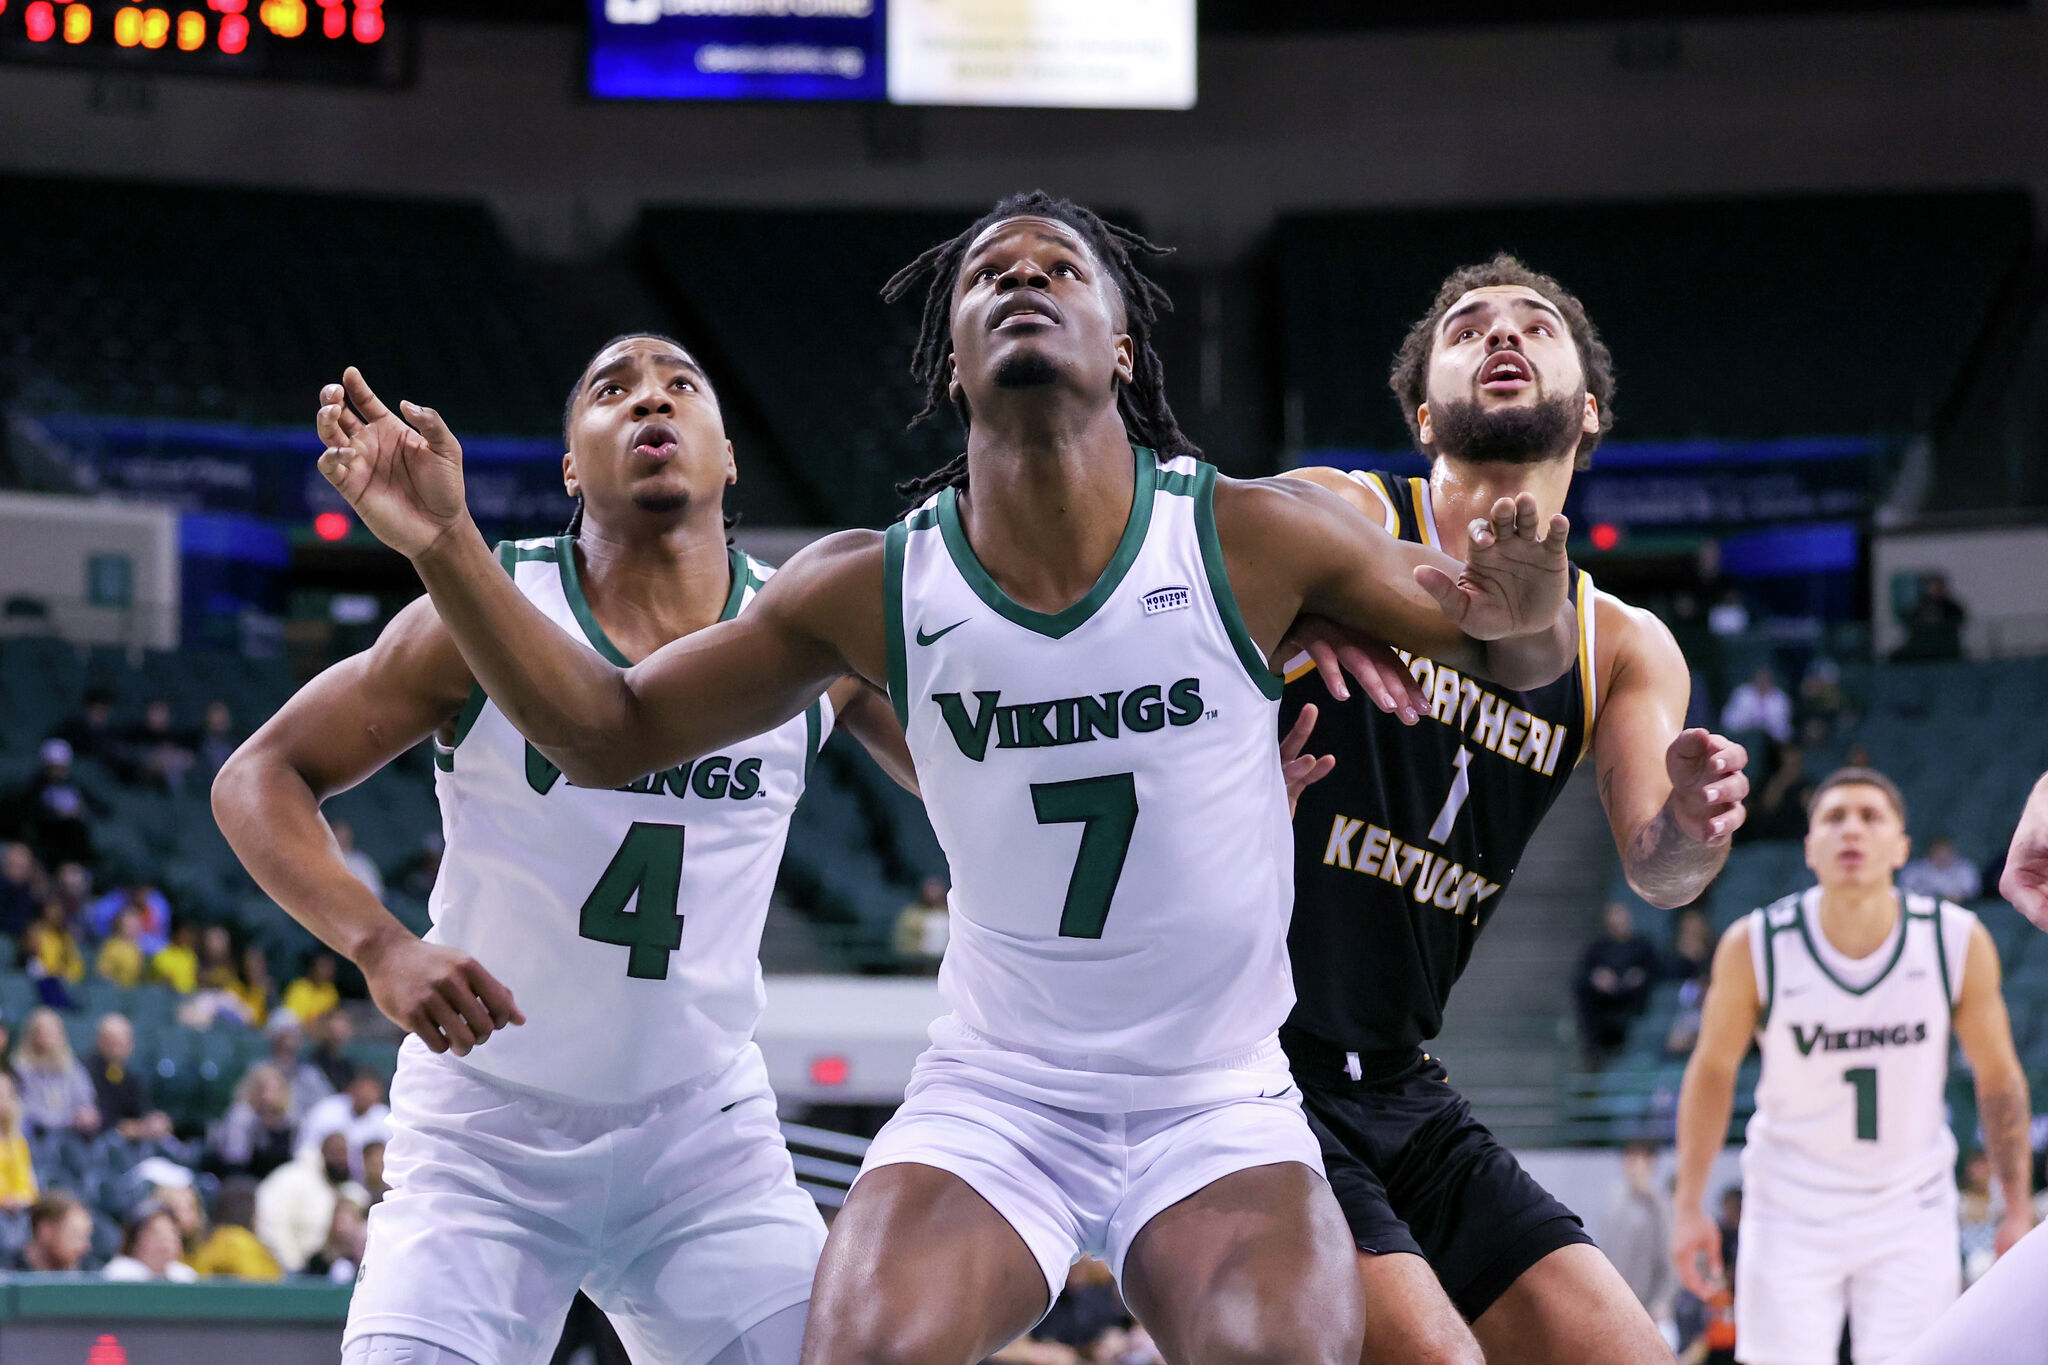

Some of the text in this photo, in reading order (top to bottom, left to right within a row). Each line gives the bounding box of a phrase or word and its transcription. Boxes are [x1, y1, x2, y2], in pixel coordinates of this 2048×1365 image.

[1145, 590, 1187, 605] HORIZON
[931, 677, 1204, 763] VIKINGS
[1427, 743, 1475, 846] 1
[1030, 771, 1139, 940] 7
[579, 821, 686, 981] 4
[1788, 1022, 1927, 1056] VIKINGS
[1843, 1067, 1878, 1141] 1
